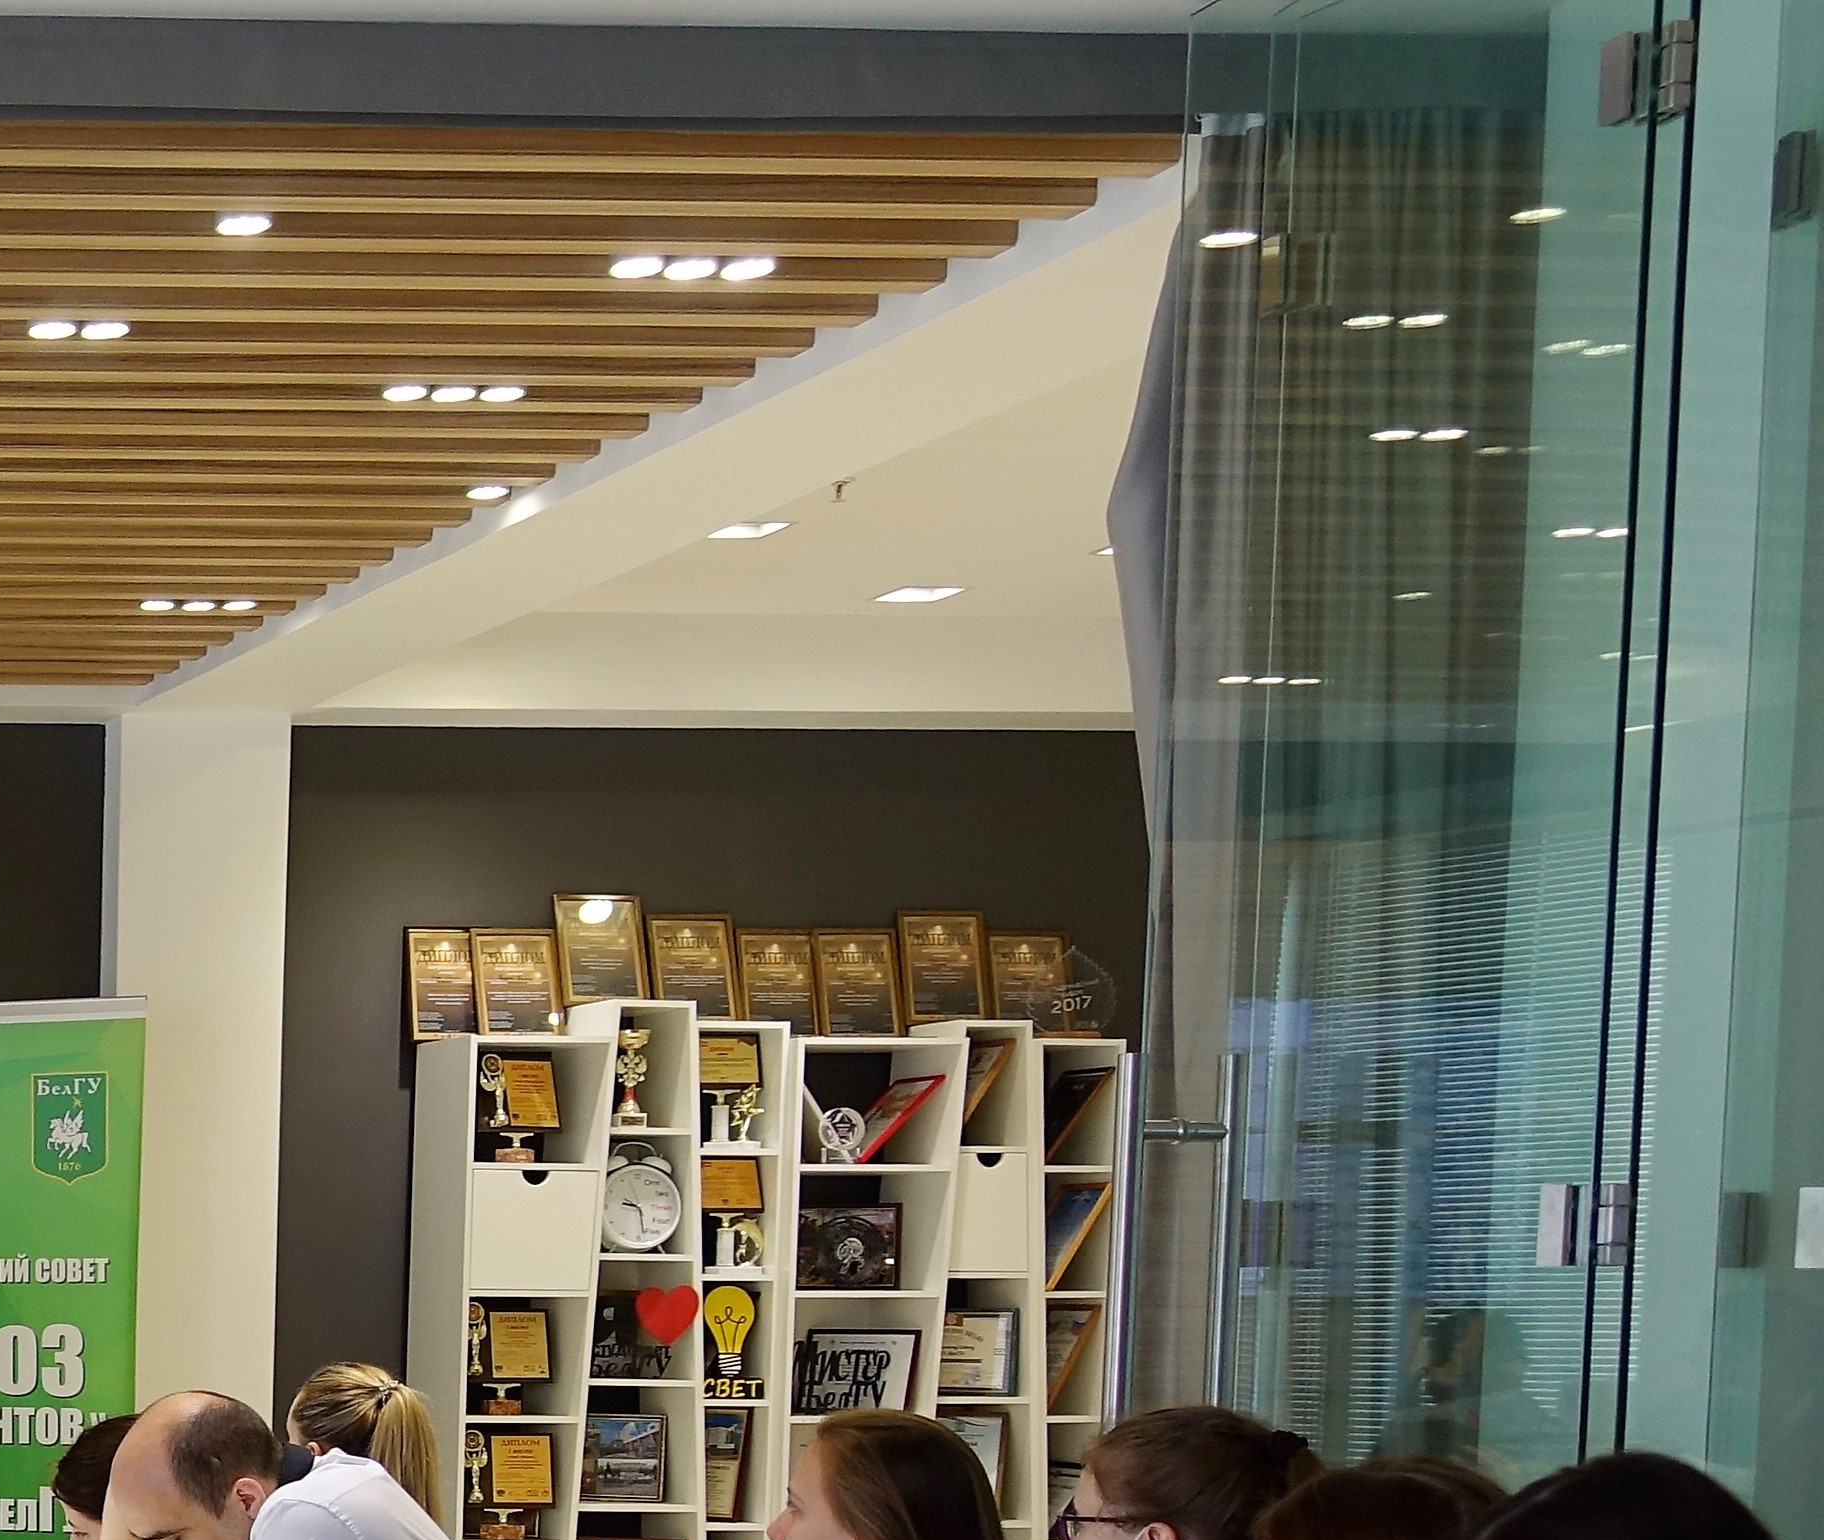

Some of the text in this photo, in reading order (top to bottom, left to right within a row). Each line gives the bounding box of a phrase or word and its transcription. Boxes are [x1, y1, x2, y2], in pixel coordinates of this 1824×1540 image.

[1051, 995, 1092, 1014] 2017
[36, 1078, 102, 1097] БелГУ
[35, 1257, 110, 1284] СОВЕТ
[704, 1378, 764, 1398] СВЕТ
